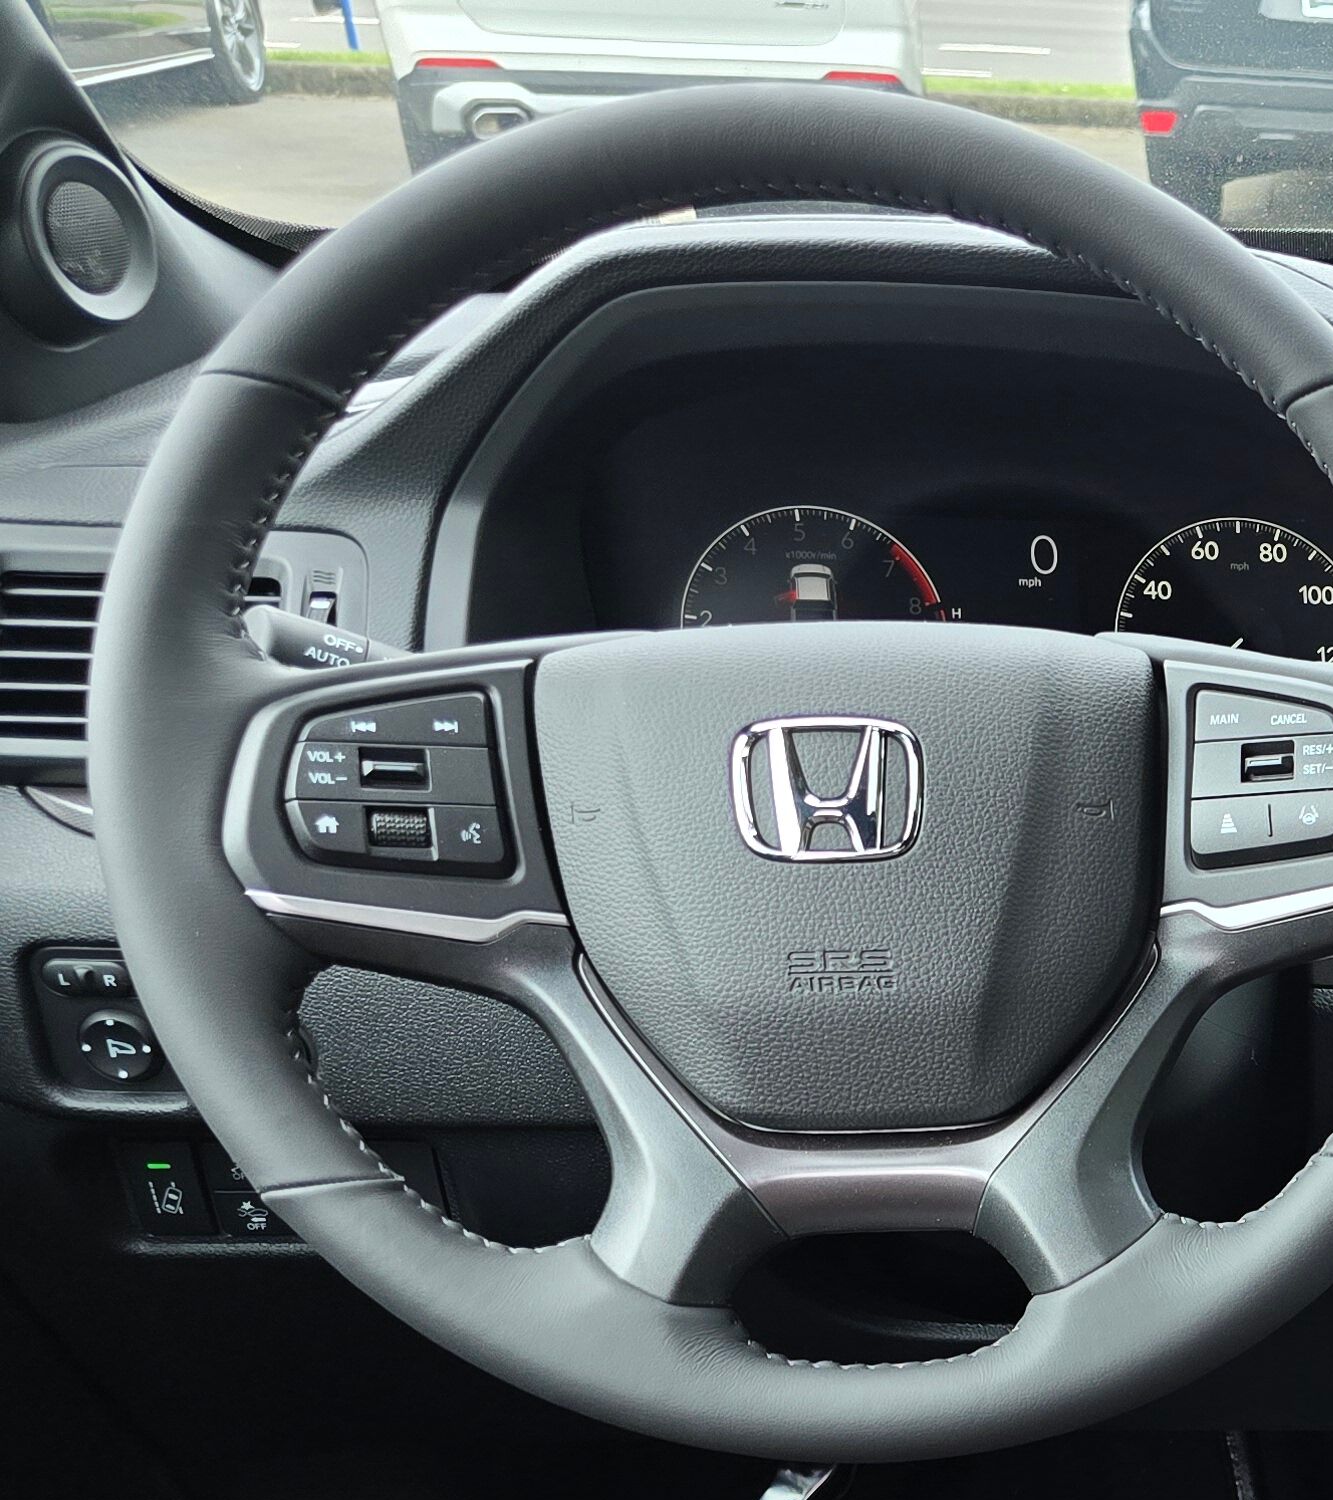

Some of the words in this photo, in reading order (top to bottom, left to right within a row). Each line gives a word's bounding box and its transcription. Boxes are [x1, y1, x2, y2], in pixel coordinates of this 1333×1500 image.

[793, 523, 806, 540] 5
[842, 531, 854, 549] 6
[744, 538, 757, 555] 4
[1030, 535, 1058, 575] 0
[1191, 541, 1219, 561] 60
[1259, 543, 1287, 564] 80
[882, 560, 895, 578] 7
[1230, 561, 1250, 572] mph
[714, 567, 728, 585] 3
[1018, 577, 1042, 588] mph
[1143, 580, 1172, 600] 40
[909, 597, 922, 615] 8
[951, 608, 961, 619] H
[700, 610, 712, 628] 2
[324, 634, 356, 652] OFF
[304, 647, 350, 667] AUTO
[1210, 714, 1239, 725] MAIN
[1270, 713, 1307, 725] CANCEL
[787, 949, 894, 974] SRS
[58, 973, 71, 986] L
[103, 974, 117, 987] R
[787, 975, 899, 995] AIRBAG
[247, 1222, 267, 1230] OFF
